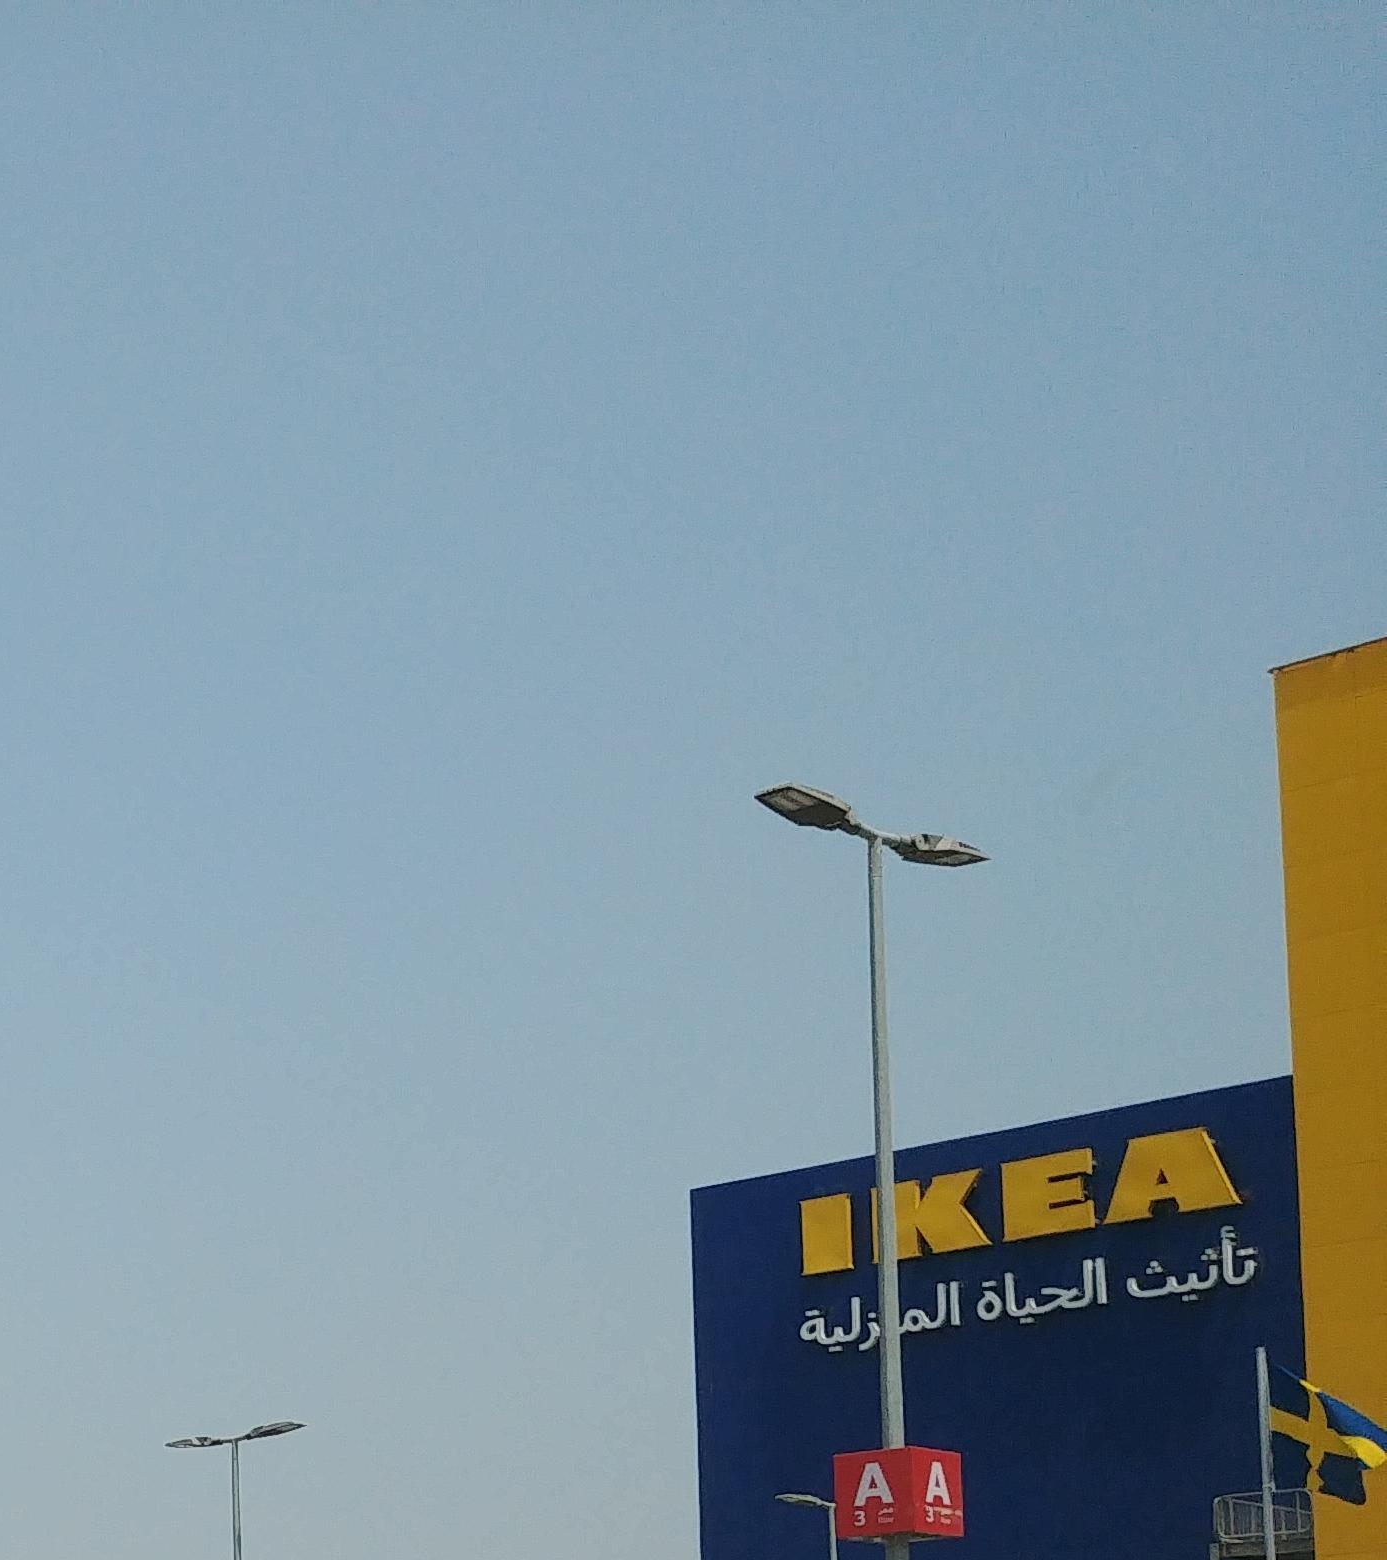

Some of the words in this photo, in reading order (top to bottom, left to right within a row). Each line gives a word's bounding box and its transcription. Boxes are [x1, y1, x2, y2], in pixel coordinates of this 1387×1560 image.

[799, 1126, 1244, 1276] IKEA
[977, 1256, 1108, 1325] الحياة
[1127, 1225, 1259, 1302] تأثيث
[799, 1280, 962, 1353] المزلية
[853, 1462, 895, 1507] A
[925, 1461, 952, 1506] A
[853, 1510, 867, 1528] 3
